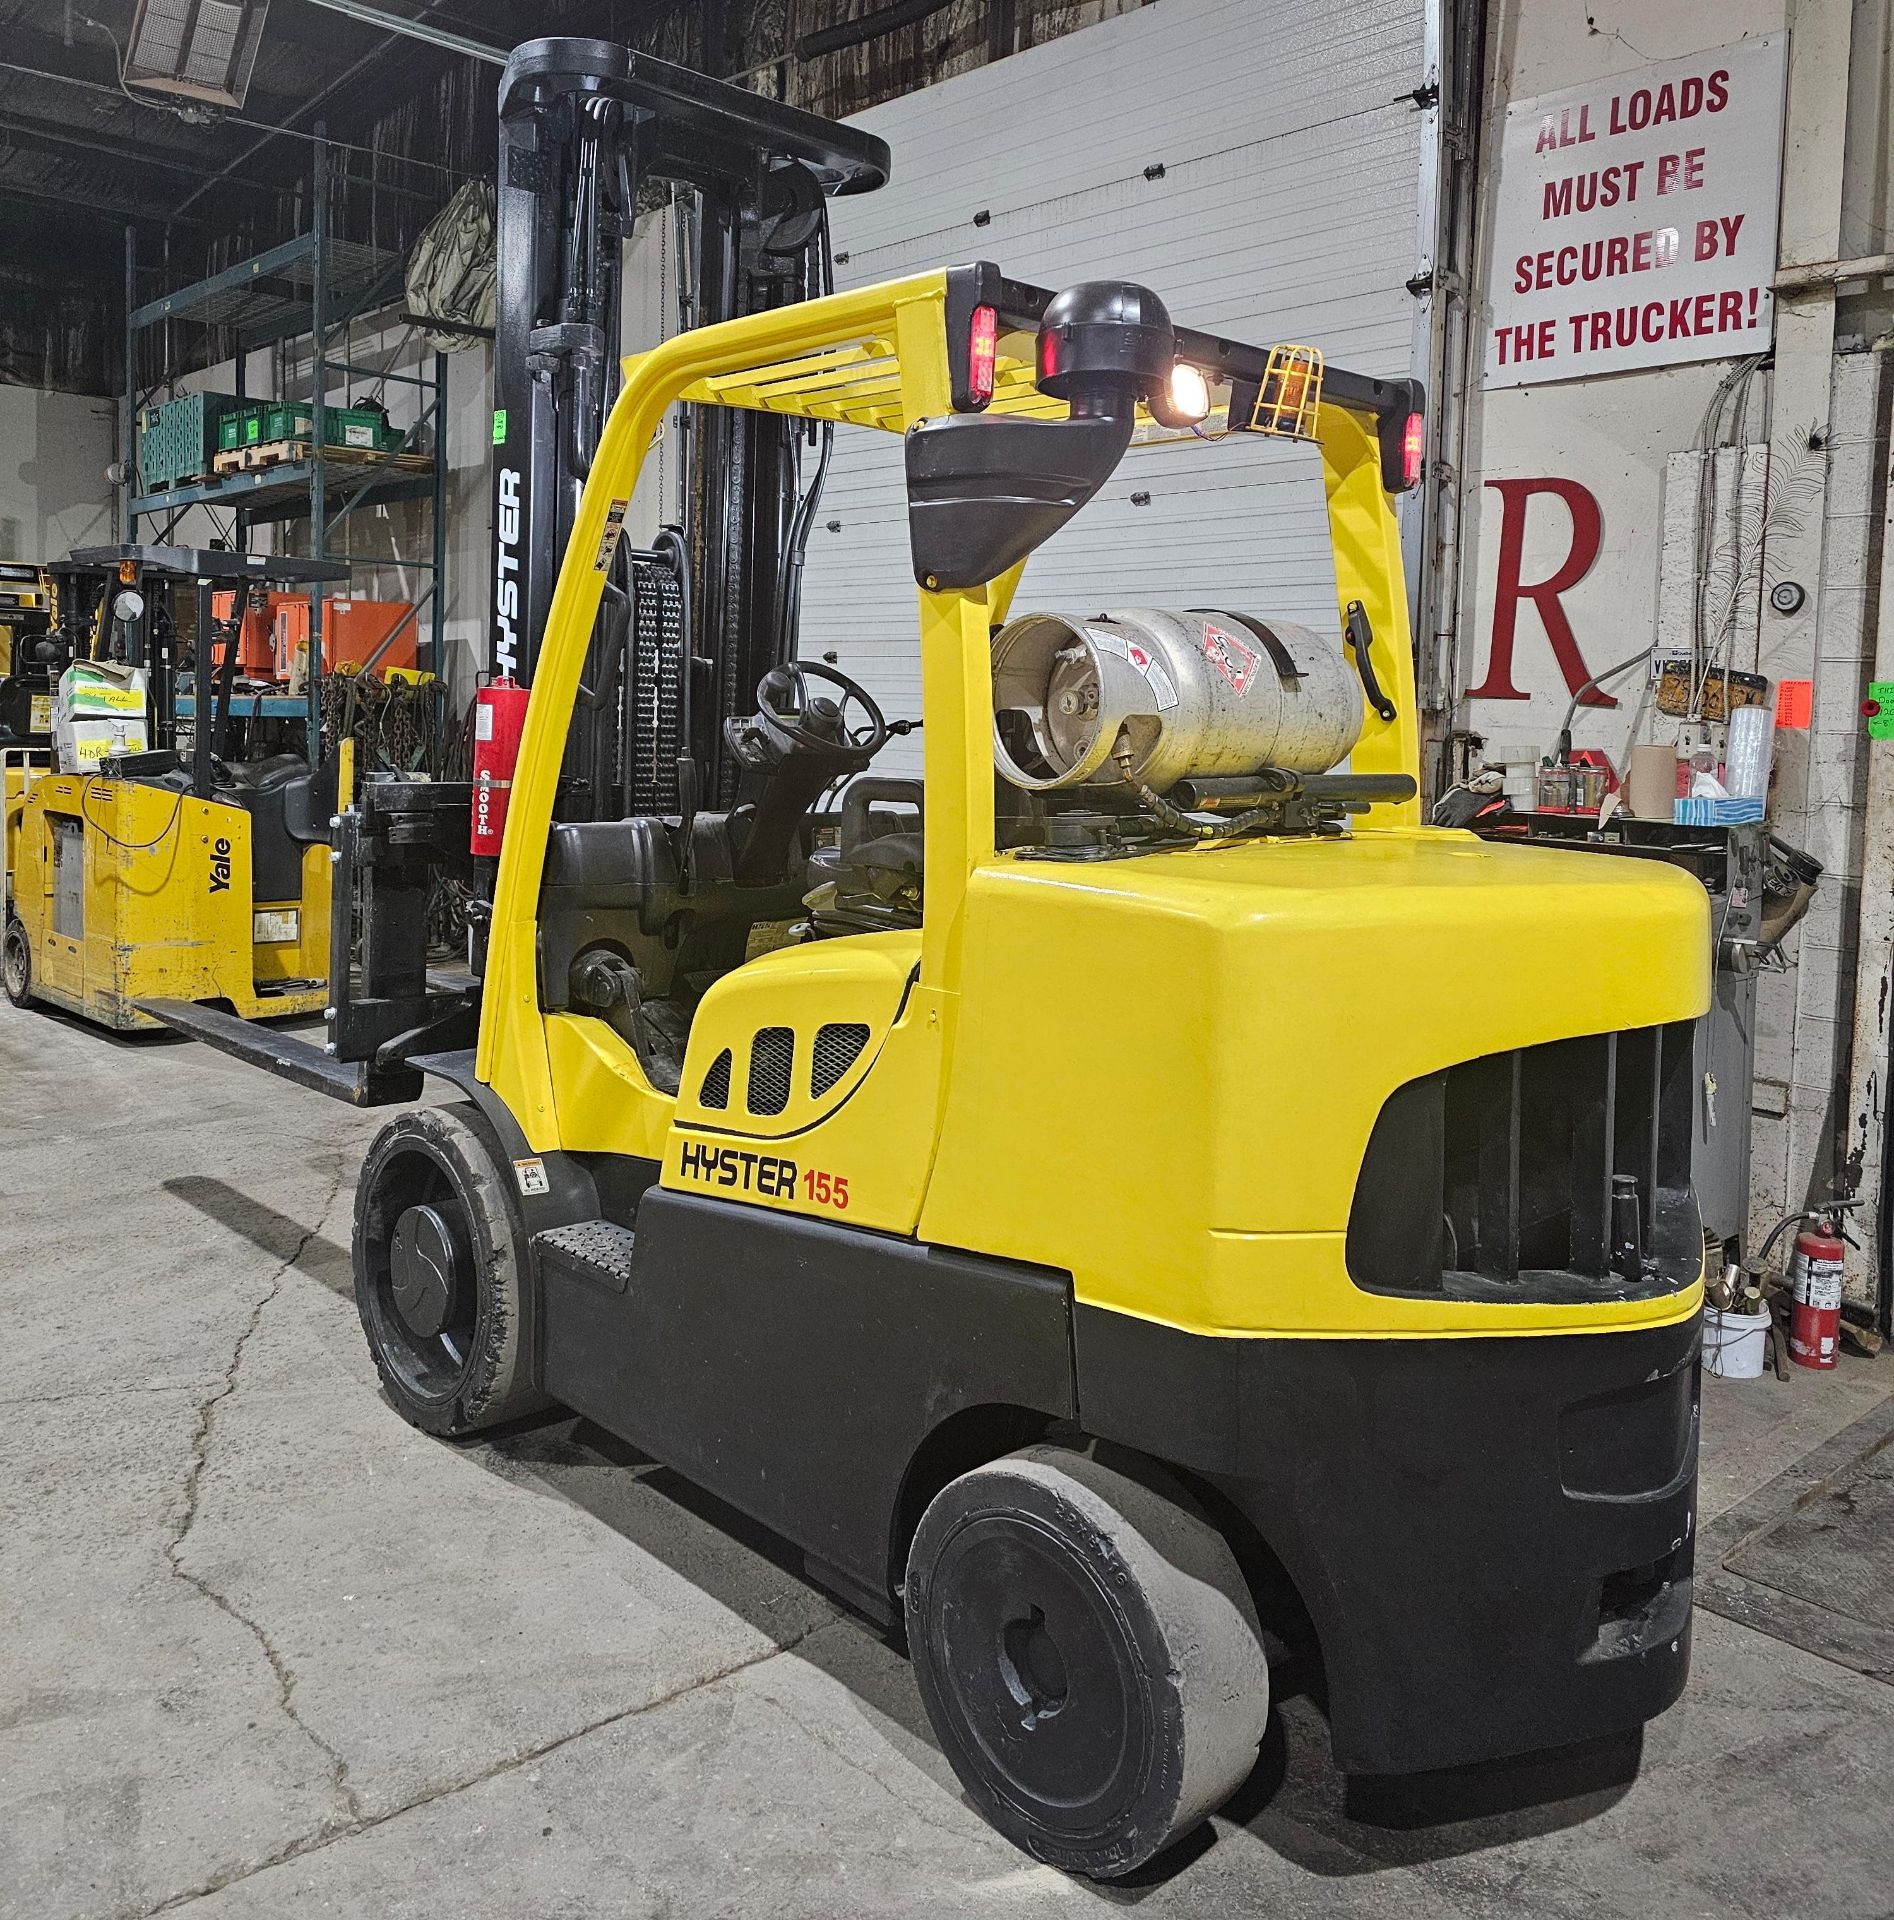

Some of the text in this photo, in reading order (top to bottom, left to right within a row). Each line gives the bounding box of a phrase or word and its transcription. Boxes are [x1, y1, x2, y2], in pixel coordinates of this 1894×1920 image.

[1535, 69, 1730, 153] ALL LOADS
[1542, 147, 1706, 220] MUST BE
[1513, 214, 1746, 294] SECURED BY
[1493, 287, 1760, 365] THE TRUCKER!
[1465, 477, 1618, 707] R
[208, 838, 231, 894] Yale
[680, 1141, 849, 1210] HYSTER 155
